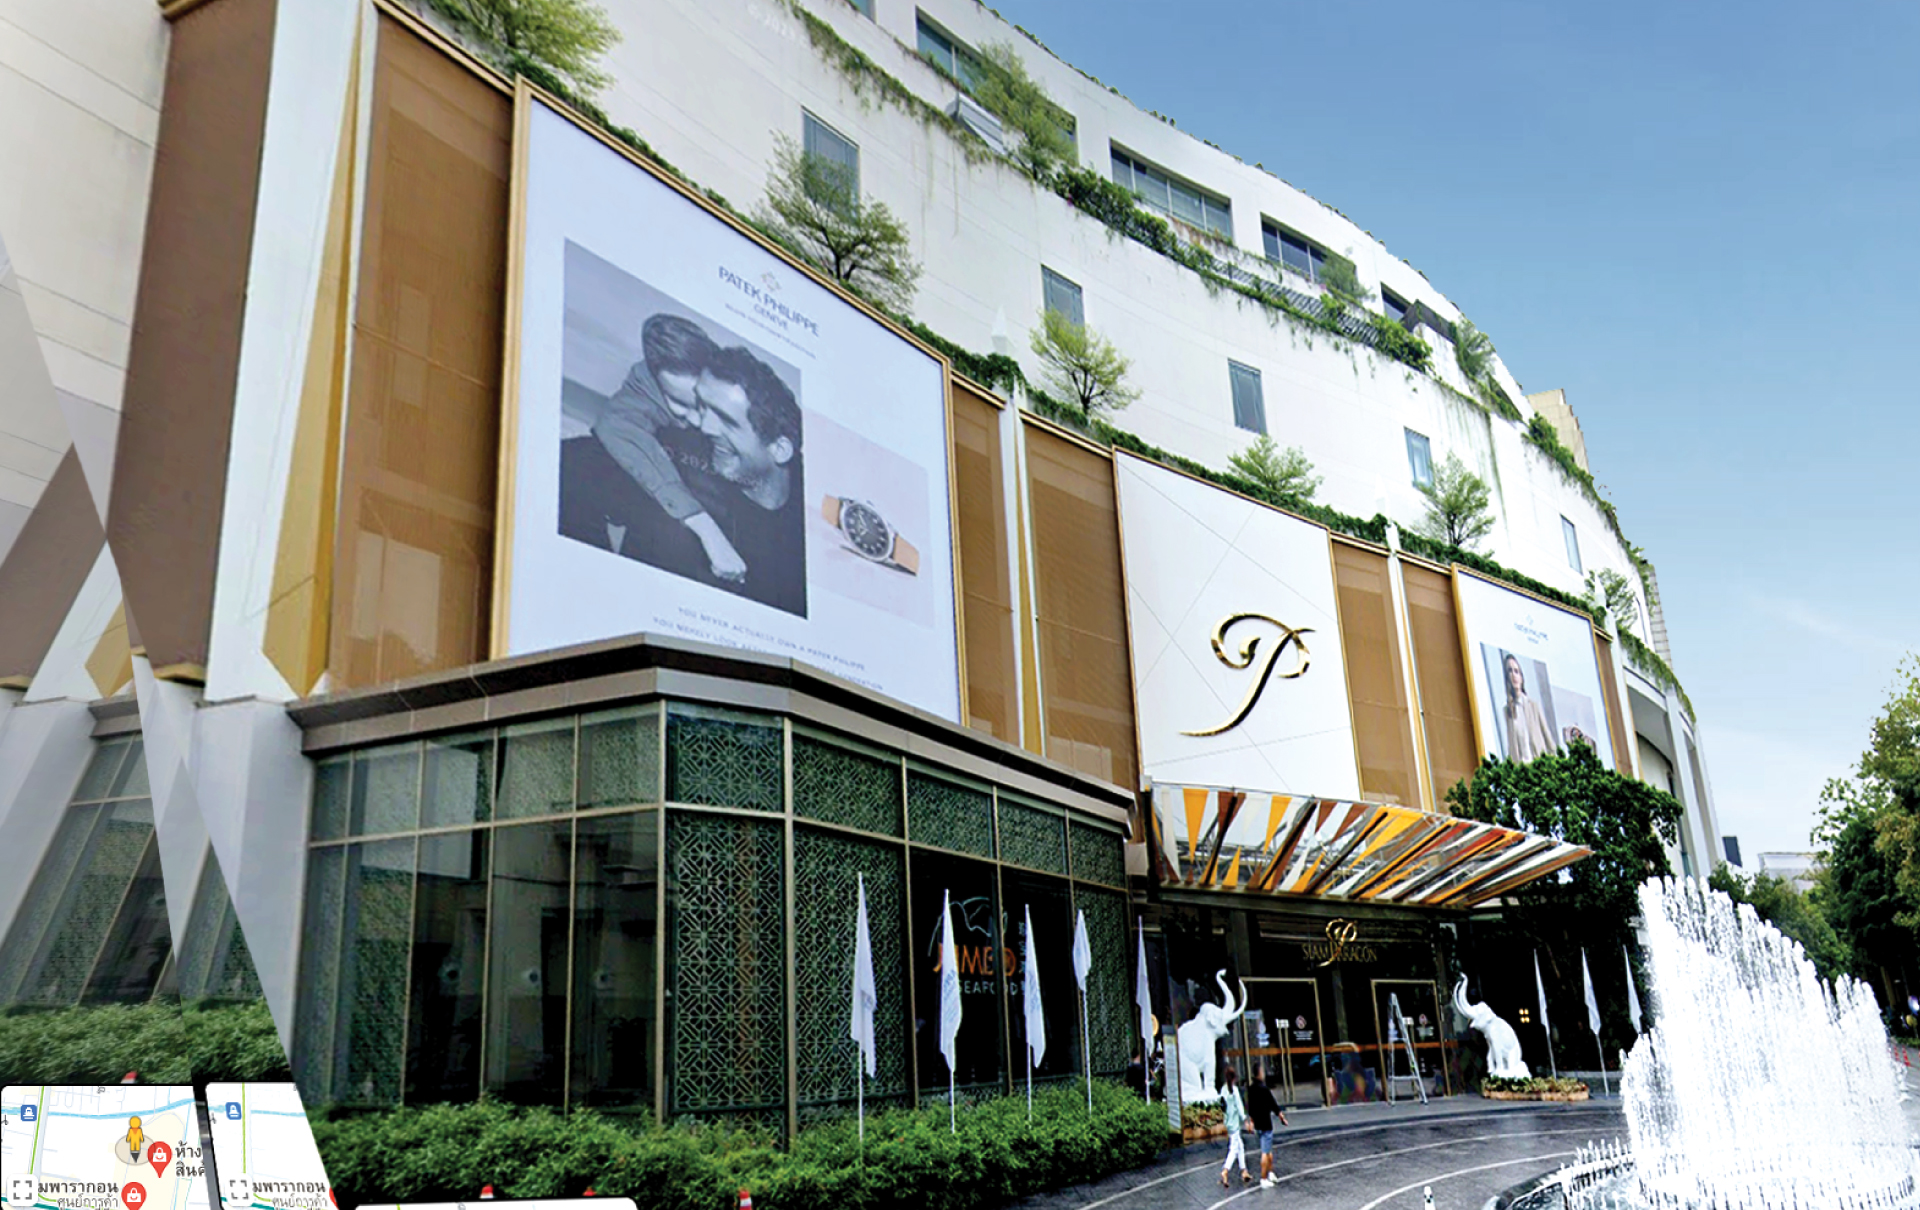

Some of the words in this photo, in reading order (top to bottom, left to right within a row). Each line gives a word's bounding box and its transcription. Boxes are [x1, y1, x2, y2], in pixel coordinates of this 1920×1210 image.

[719, 265, 762, 302] PATEK
[763, 292, 819, 339] PHILIPPE
[932, 941, 1017, 977] JMBO
[1302, 942, 1329, 960] SIAM
